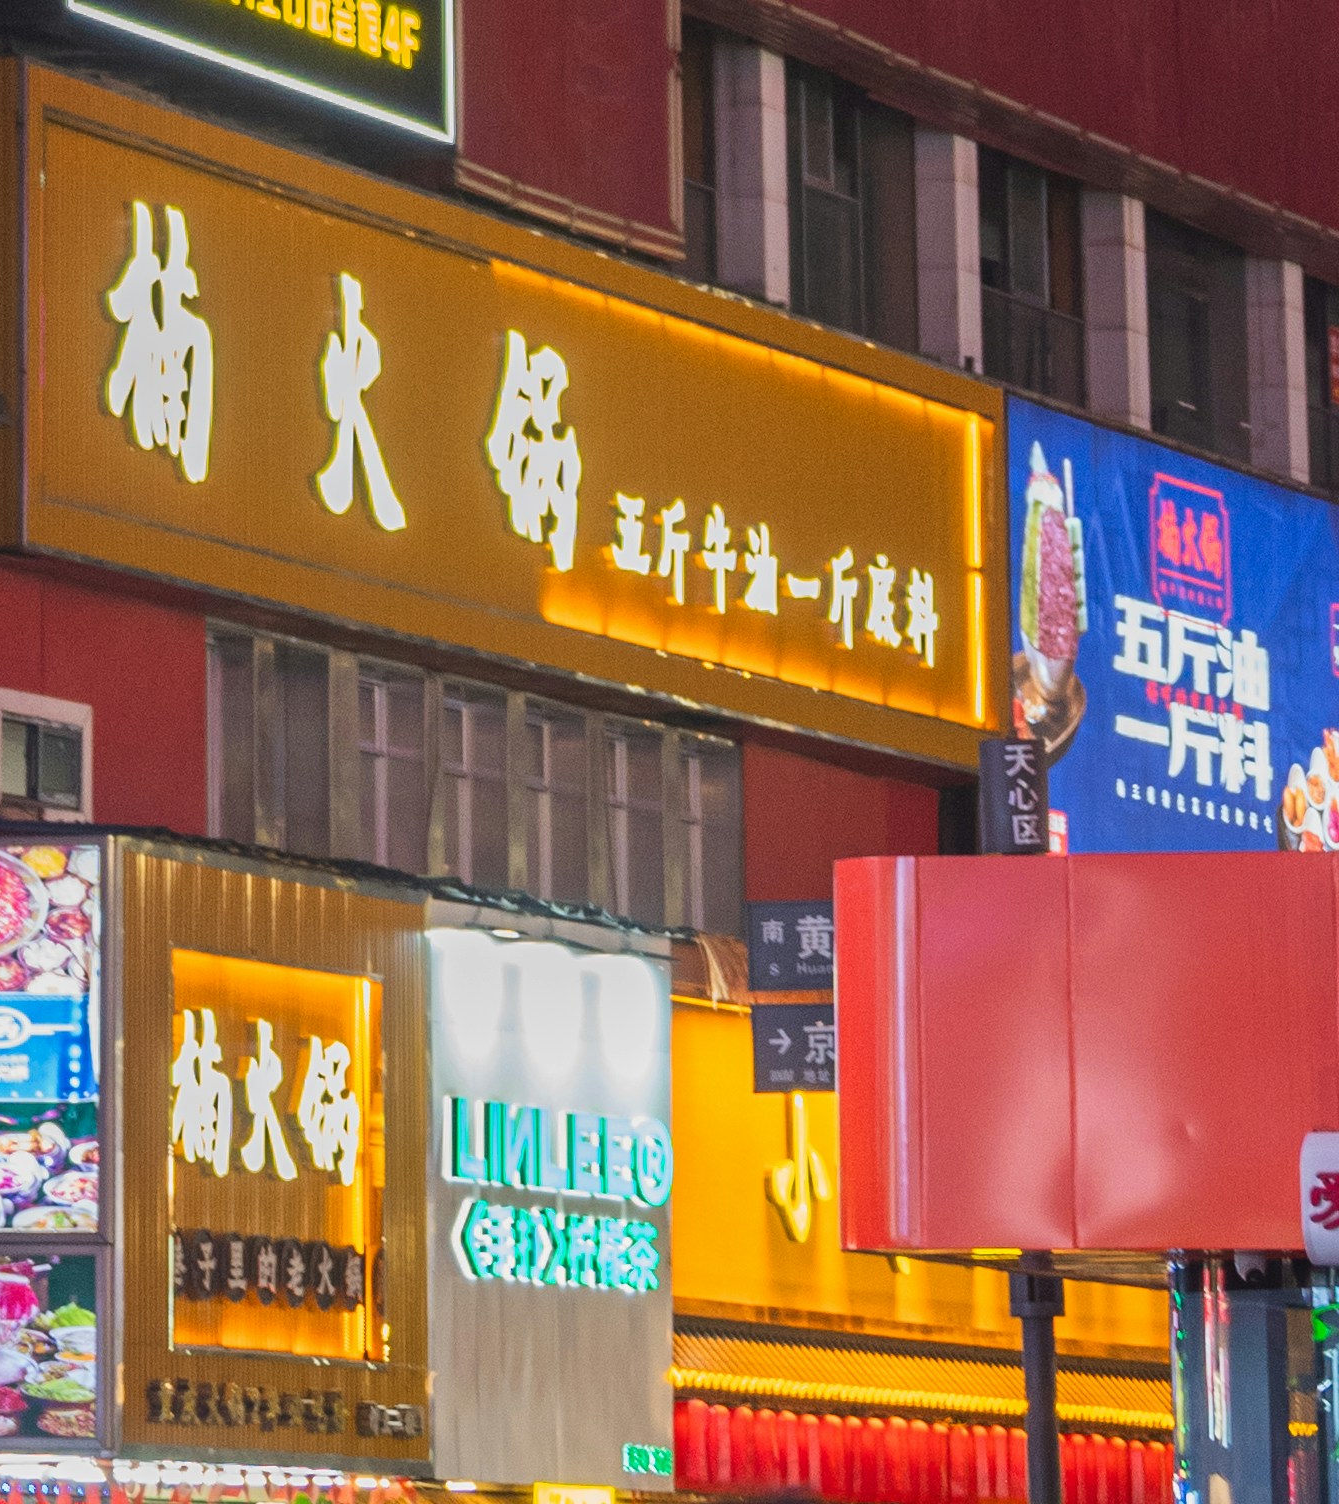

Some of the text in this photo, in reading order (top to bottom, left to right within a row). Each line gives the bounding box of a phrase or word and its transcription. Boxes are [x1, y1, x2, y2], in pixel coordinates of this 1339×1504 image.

[108, 199, 581, 571] 楠火锅
[607, 491, 940, 668] 五斤牛油一斤底料
[1113, 594, 1270, 712] 五斤油
[1005, 745, 1040, 846] 天心区
[1115, 703, 1273, 801] 一斤料
[761, 919, 785, 944] 南
[769, 963, 779, 976] S
[173, 1008, 359, 1185] 楠火锅
